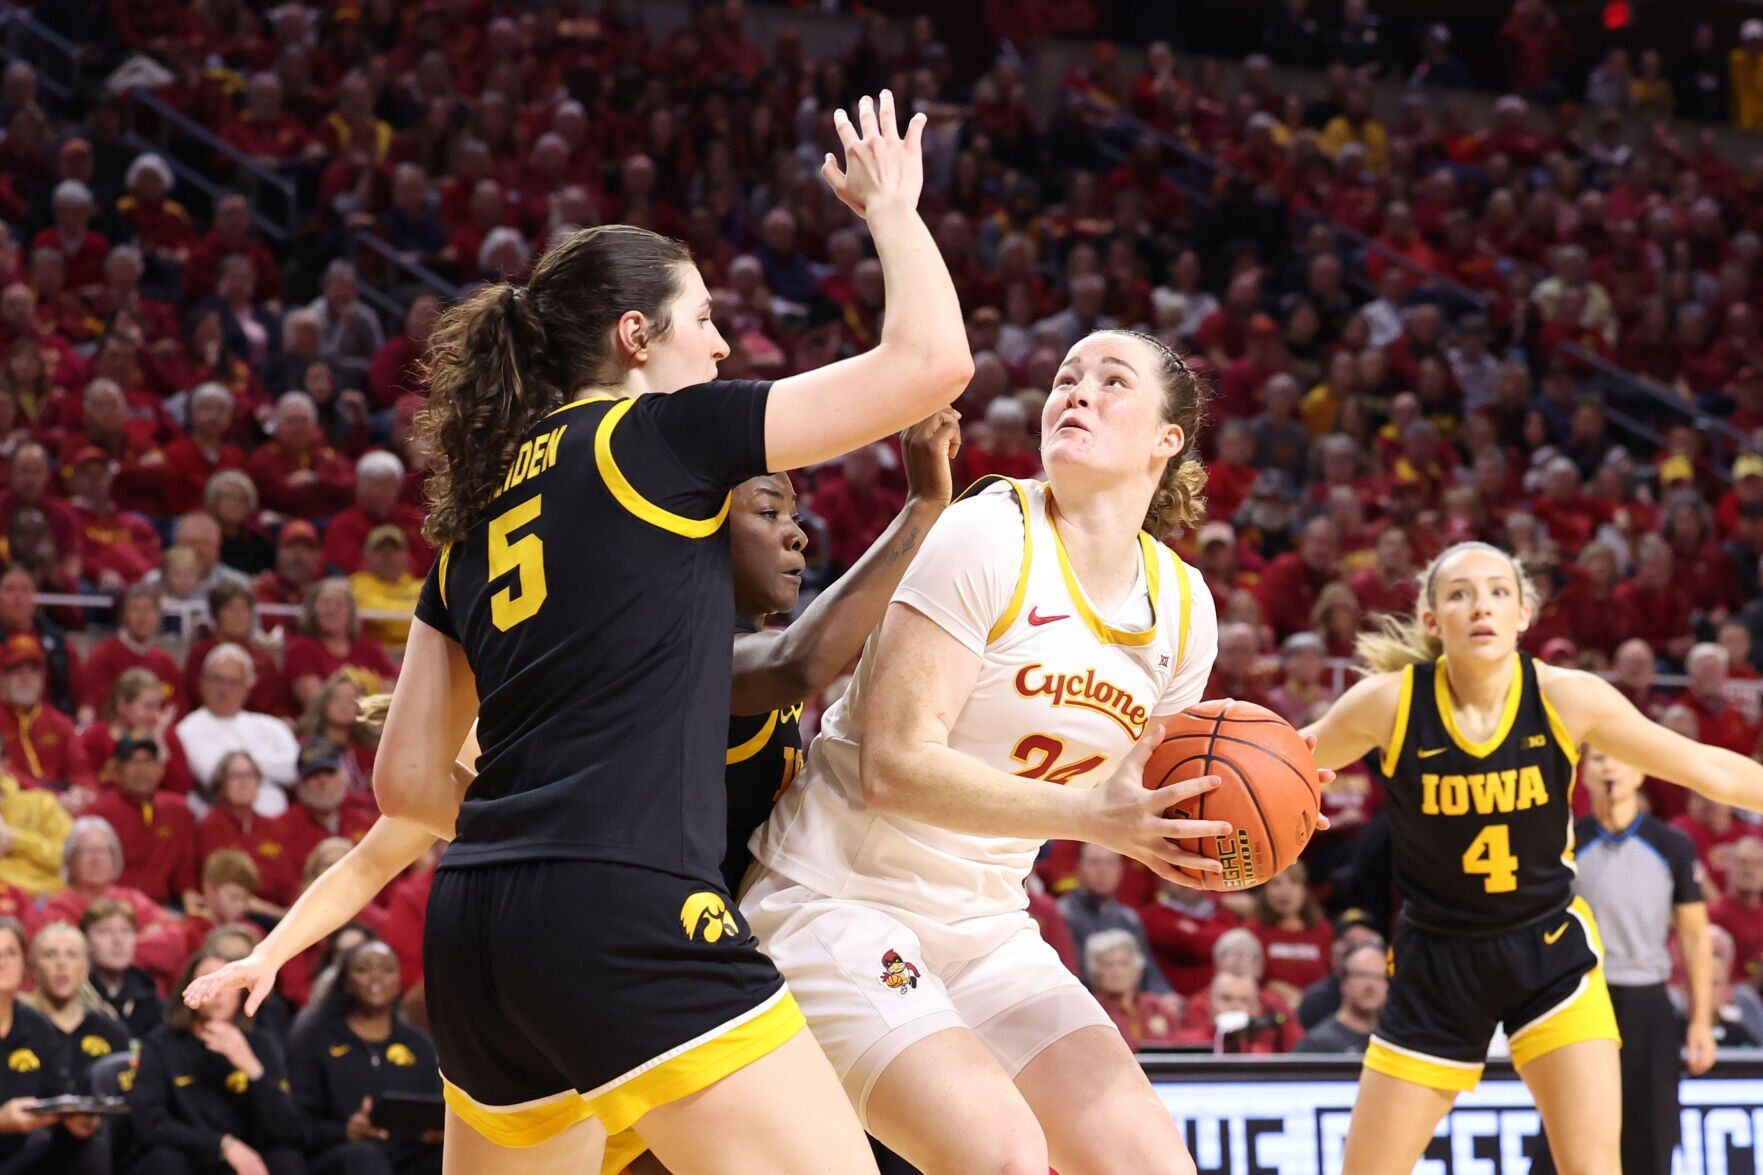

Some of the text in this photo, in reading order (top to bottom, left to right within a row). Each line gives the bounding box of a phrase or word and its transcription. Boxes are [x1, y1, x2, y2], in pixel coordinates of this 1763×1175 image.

[488, 493, 548, 633] 5
[1014, 662, 1149, 744] Cyclone
[1421, 765, 1549, 816] IOWA
[1462, 824, 1519, 893] 4
